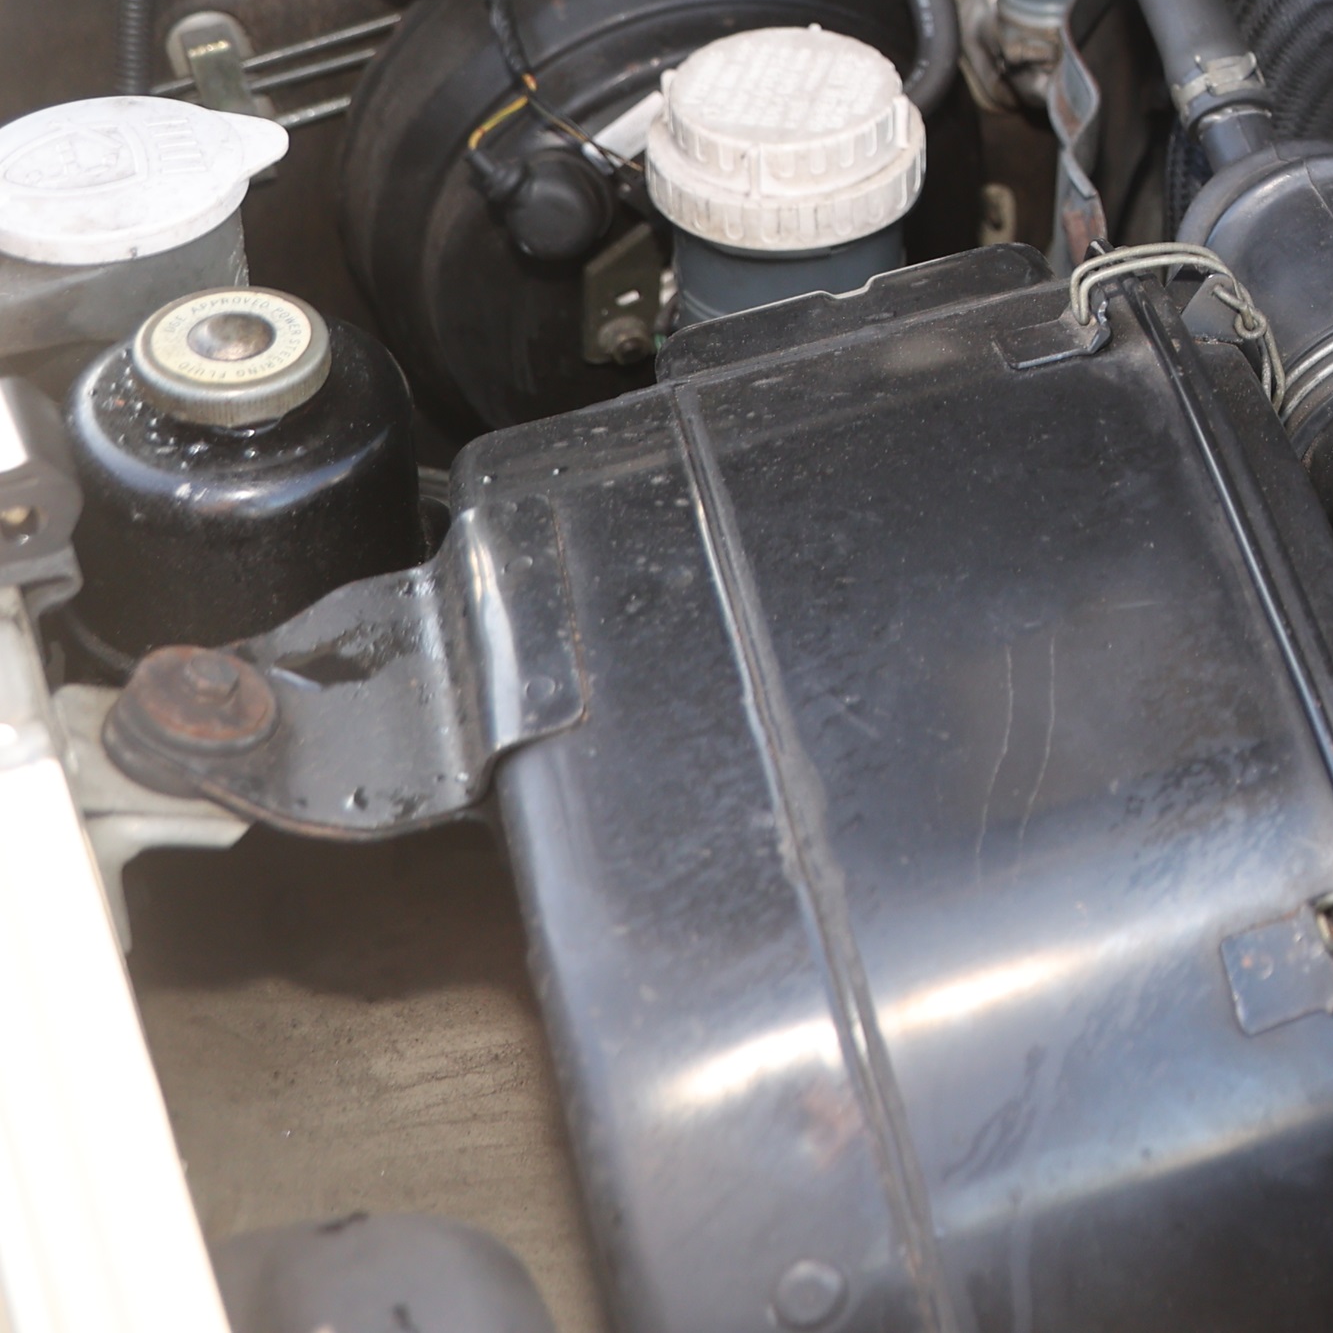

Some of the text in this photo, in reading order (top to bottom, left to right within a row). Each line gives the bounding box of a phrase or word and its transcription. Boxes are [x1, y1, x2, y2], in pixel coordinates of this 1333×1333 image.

[191, 296, 271, 315] APPROVED
[165, 315, 185, 334] USE
[275, 307, 302, 336] POWER
[179, 362, 227, 379] FLUID
